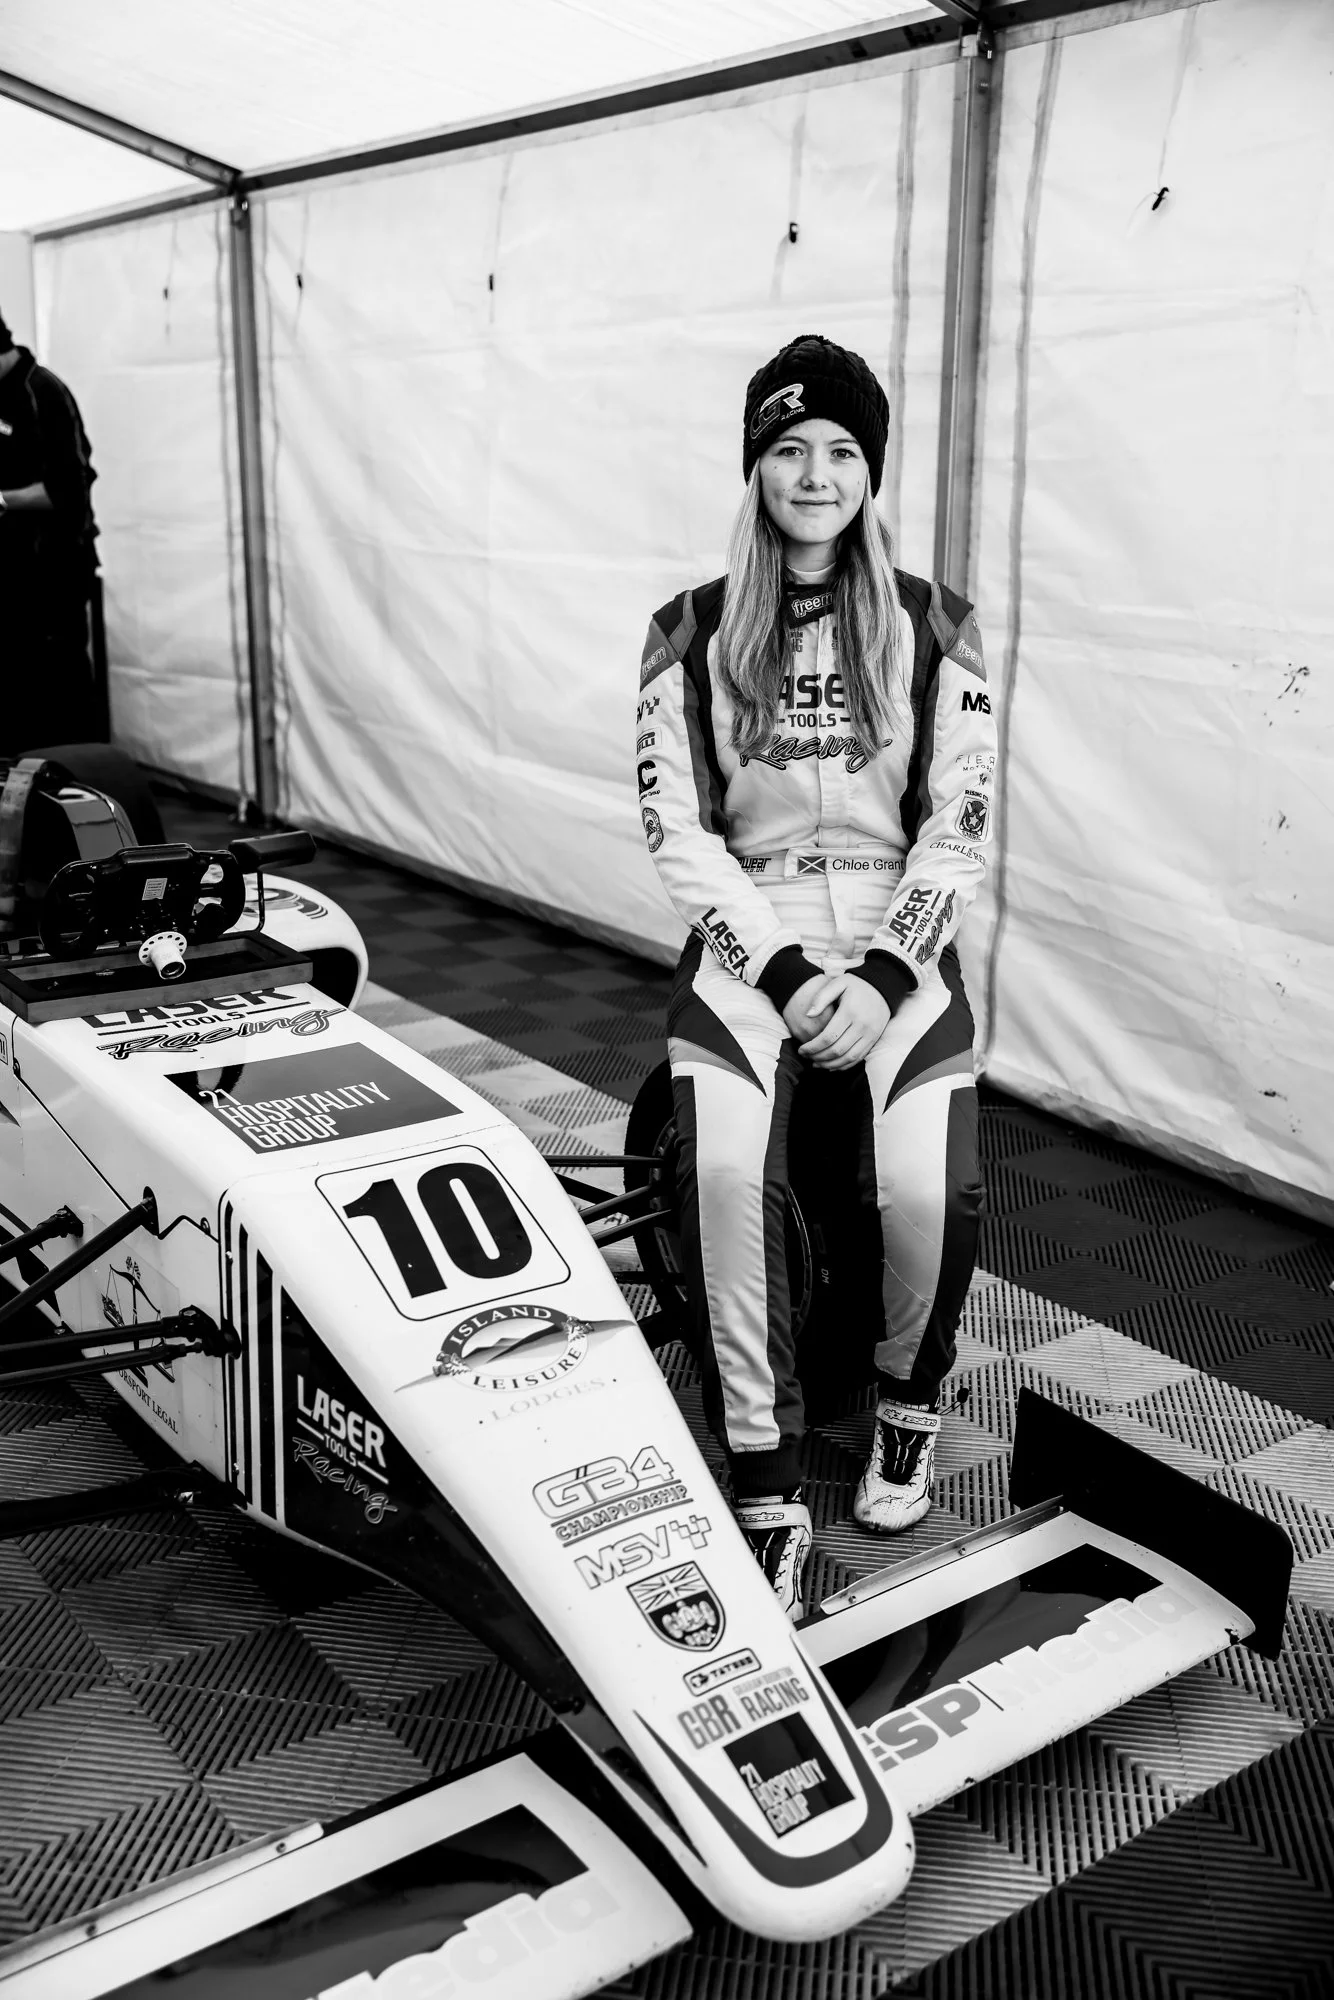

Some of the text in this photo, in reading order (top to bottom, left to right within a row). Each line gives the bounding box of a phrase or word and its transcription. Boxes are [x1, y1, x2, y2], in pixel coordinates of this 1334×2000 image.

[791, 592, 833, 618] freem
[778, 673, 845, 709] ASE
[961, 690, 993, 715] MS
[787, 713, 837, 728] TOOLS
[832, 858, 906, 871] Chloe Grant
[888, 888, 933, 947] ASER
[914, 909, 933, 937] TOOLS
[96, 1008, 347, 1060] Racing
[166, 1011, 247, 1030] TOOLS
[199, 1087, 242, 1110] 21
[218, 1081, 391, 1128] HOSPITALITY
[242, 1114, 340, 1149] GROUP
[342, 1162, 533, 1299] 10
[450, 1306, 552, 1346] ISLAND
[472, 1347, 582, 1390] LEISURE
[152, 1400, 179, 1435] LEGAL
[491, 1376, 606, 1421] LODGES
[297, 1374, 387, 1469] LASER
[324, 1433, 357, 1468] TOOLS
[292, 1436, 398, 1524] Racing
[532, 1445, 675, 1519] GB4
[555, 1484, 688, 1541] CHAMPIONSHIP
[574, 1525, 671, 1590] MSV
[970, 1586, 1199, 1708] Media
[677, 1694, 742, 1750] GBR
[740, 1677, 810, 1722] RACING
